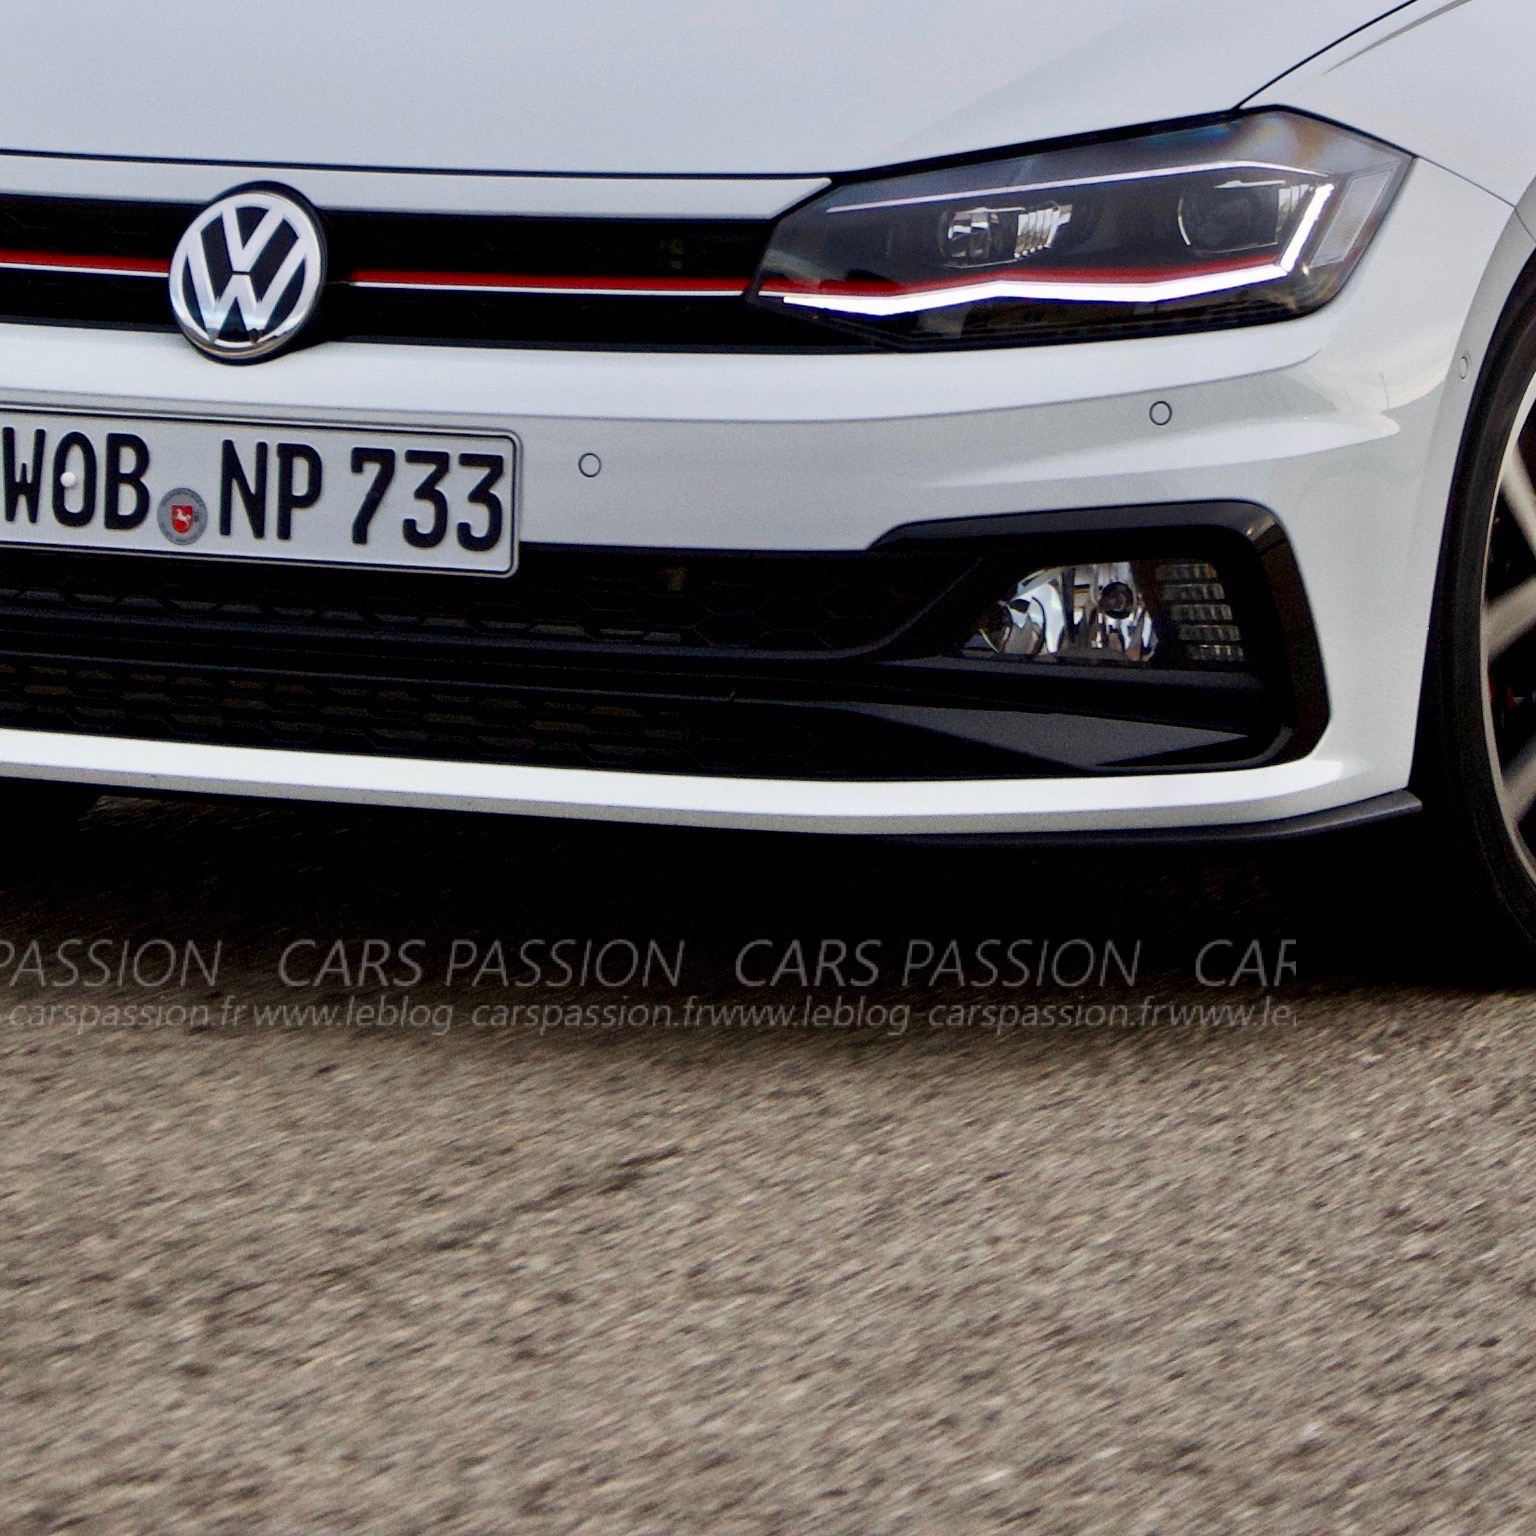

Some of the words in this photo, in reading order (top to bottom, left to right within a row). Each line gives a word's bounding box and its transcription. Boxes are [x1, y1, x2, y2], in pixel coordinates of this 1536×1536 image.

[1, 425, 151, 532] WOB
[218, 438, 323, 542] NP
[350, 446, 505, 553] 733
